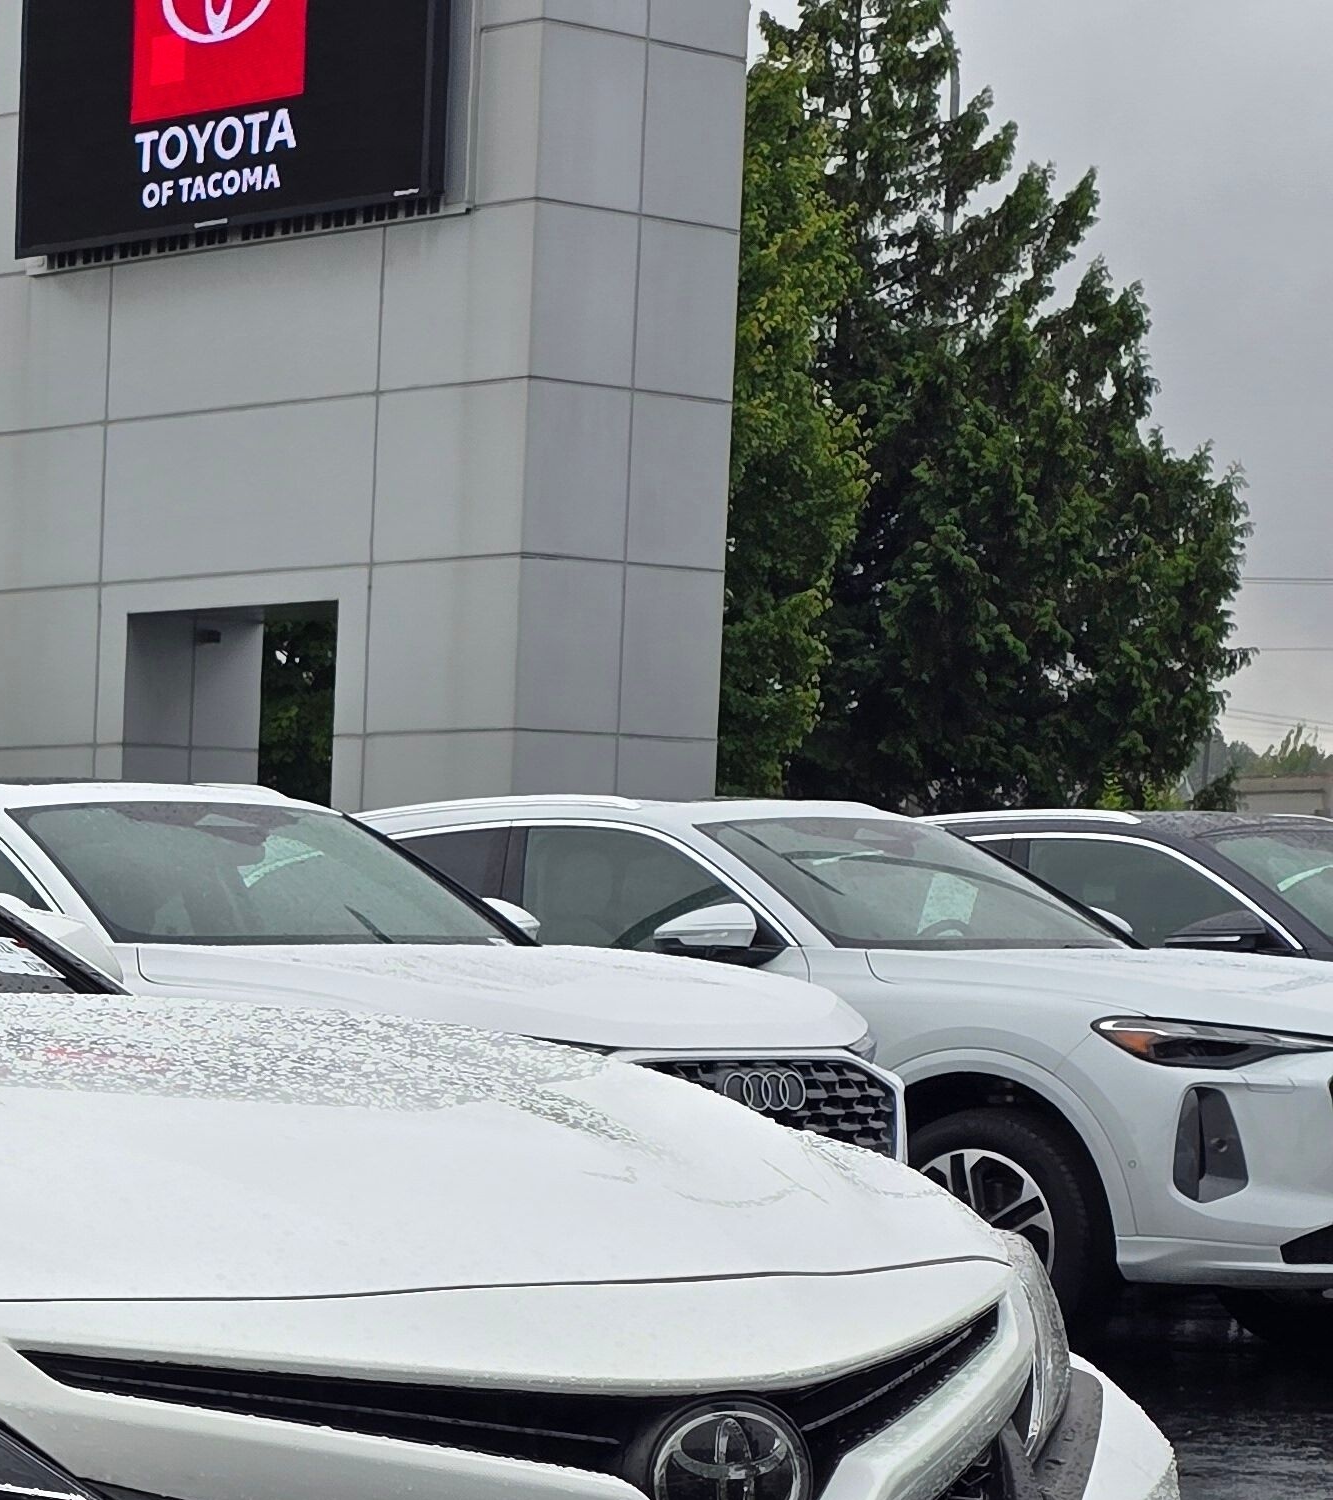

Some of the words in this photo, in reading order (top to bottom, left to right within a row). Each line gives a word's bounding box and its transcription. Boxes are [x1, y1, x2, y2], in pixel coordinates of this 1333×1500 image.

[134, 108, 297, 173] TOYOTA
[142, 180, 175, 209] OF
[178, 163, 281, 203] TACOMA
